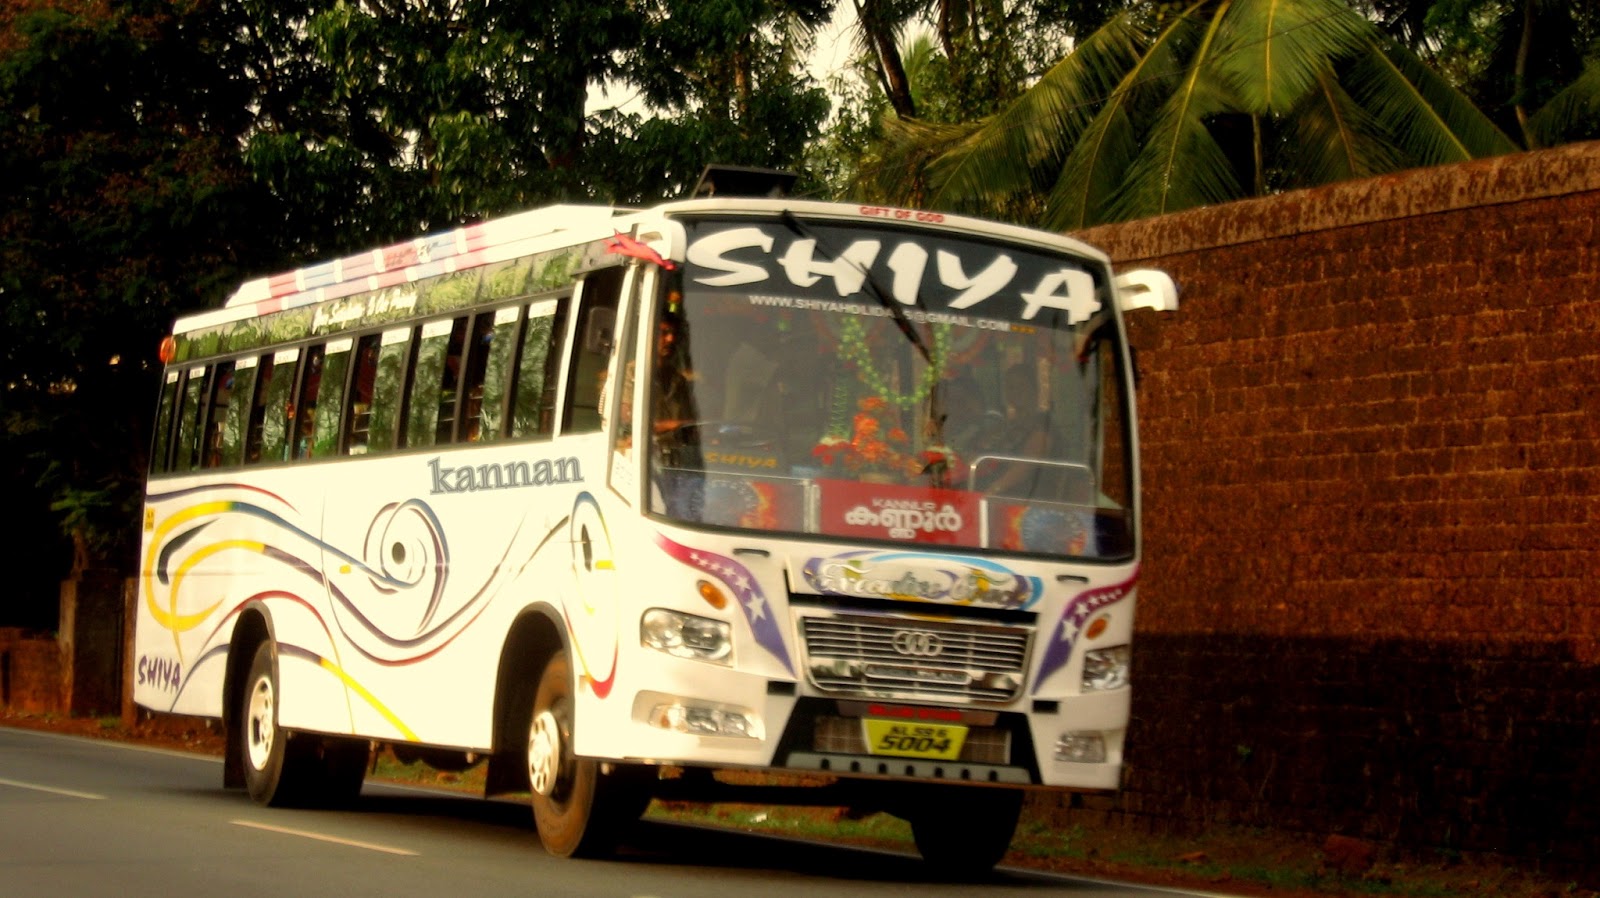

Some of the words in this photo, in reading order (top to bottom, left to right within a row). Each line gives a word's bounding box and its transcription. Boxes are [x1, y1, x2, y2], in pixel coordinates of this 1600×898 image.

[860, 206, 890, 218] GIFT
[895, 209, 911, 220] OF
[916, 211, 944, 223] GOD
[686, 227, 1102, 325] SHIYA
[427, 456, 585, 495] kannan
[138, 654, 180, 695] SHIYA
[878, 735, 952, 754] 5004
